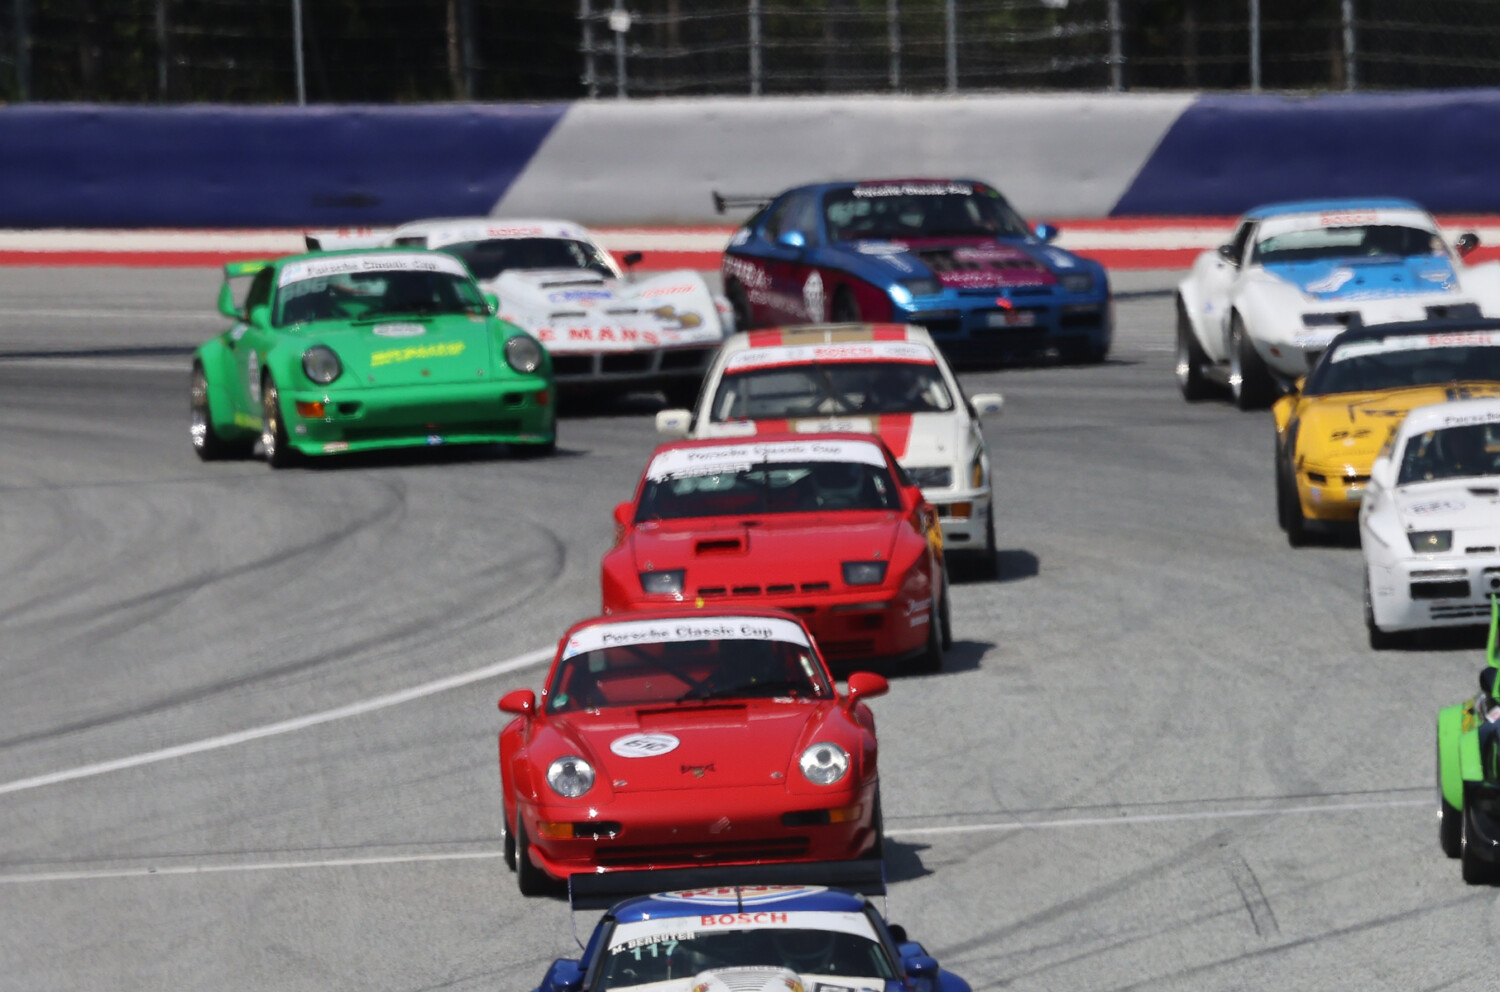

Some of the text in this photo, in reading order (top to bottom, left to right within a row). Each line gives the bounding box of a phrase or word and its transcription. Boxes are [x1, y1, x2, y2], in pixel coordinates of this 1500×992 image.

[740, 625, 774, 638] Cup
[700, 912, 788, 927] BOSCH
[630, 940, 679, 961] 117
